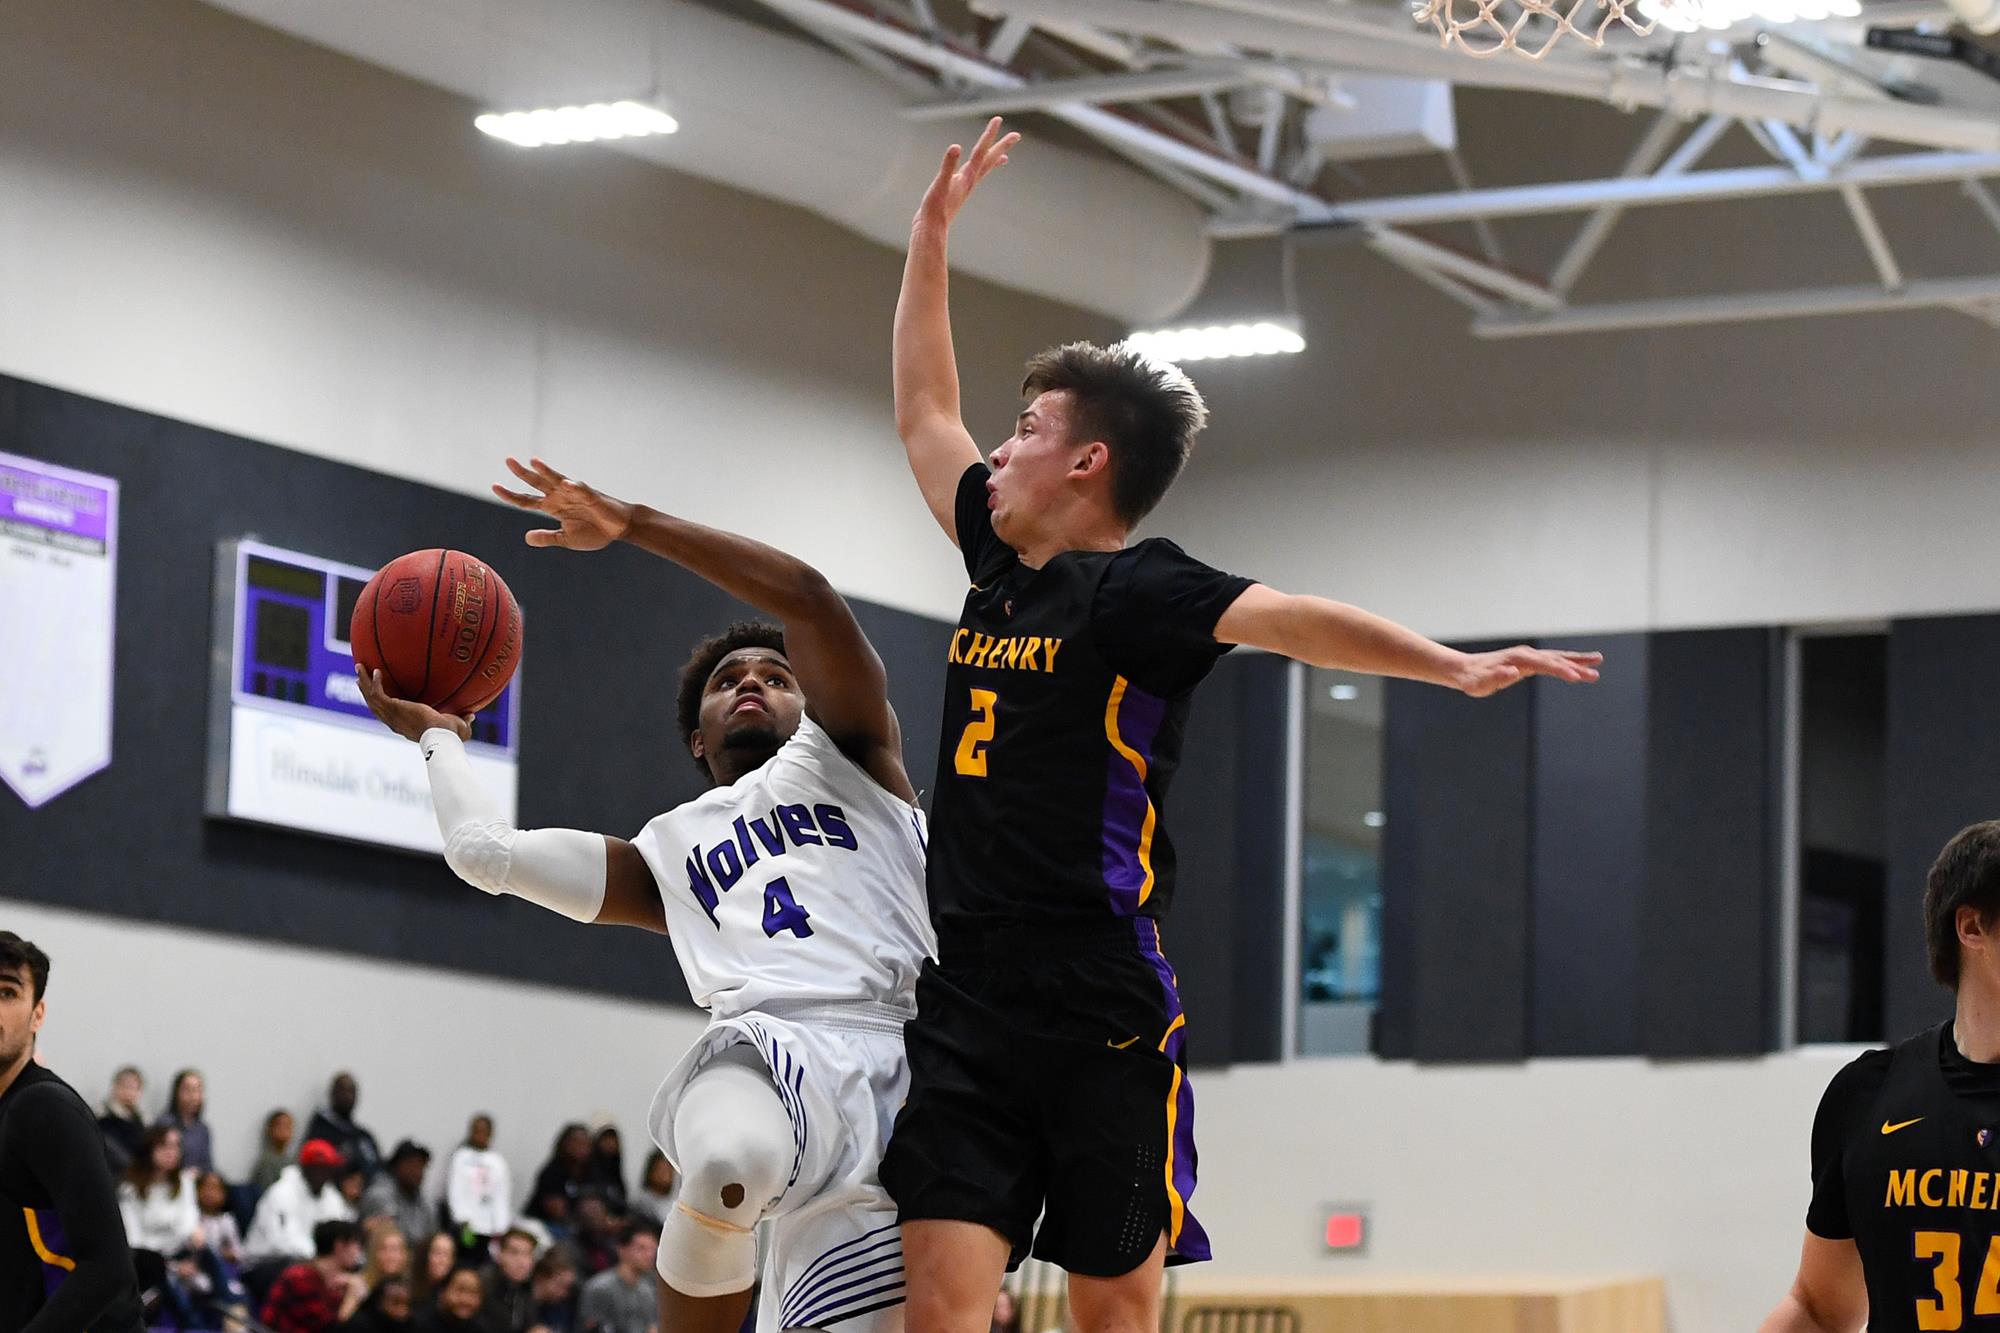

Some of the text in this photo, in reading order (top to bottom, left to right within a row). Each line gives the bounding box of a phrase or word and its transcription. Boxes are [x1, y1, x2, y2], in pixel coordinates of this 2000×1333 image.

[454, 581, 467, 621] LEGACY
[954, 687, 999, 777] 2
[272, 749, 360, 794] Hinsdale
[686, 804, 859, 932] Wolves
[762, 876, 815, 939] 4
[1913, 1230, 2000, 1332] 34
